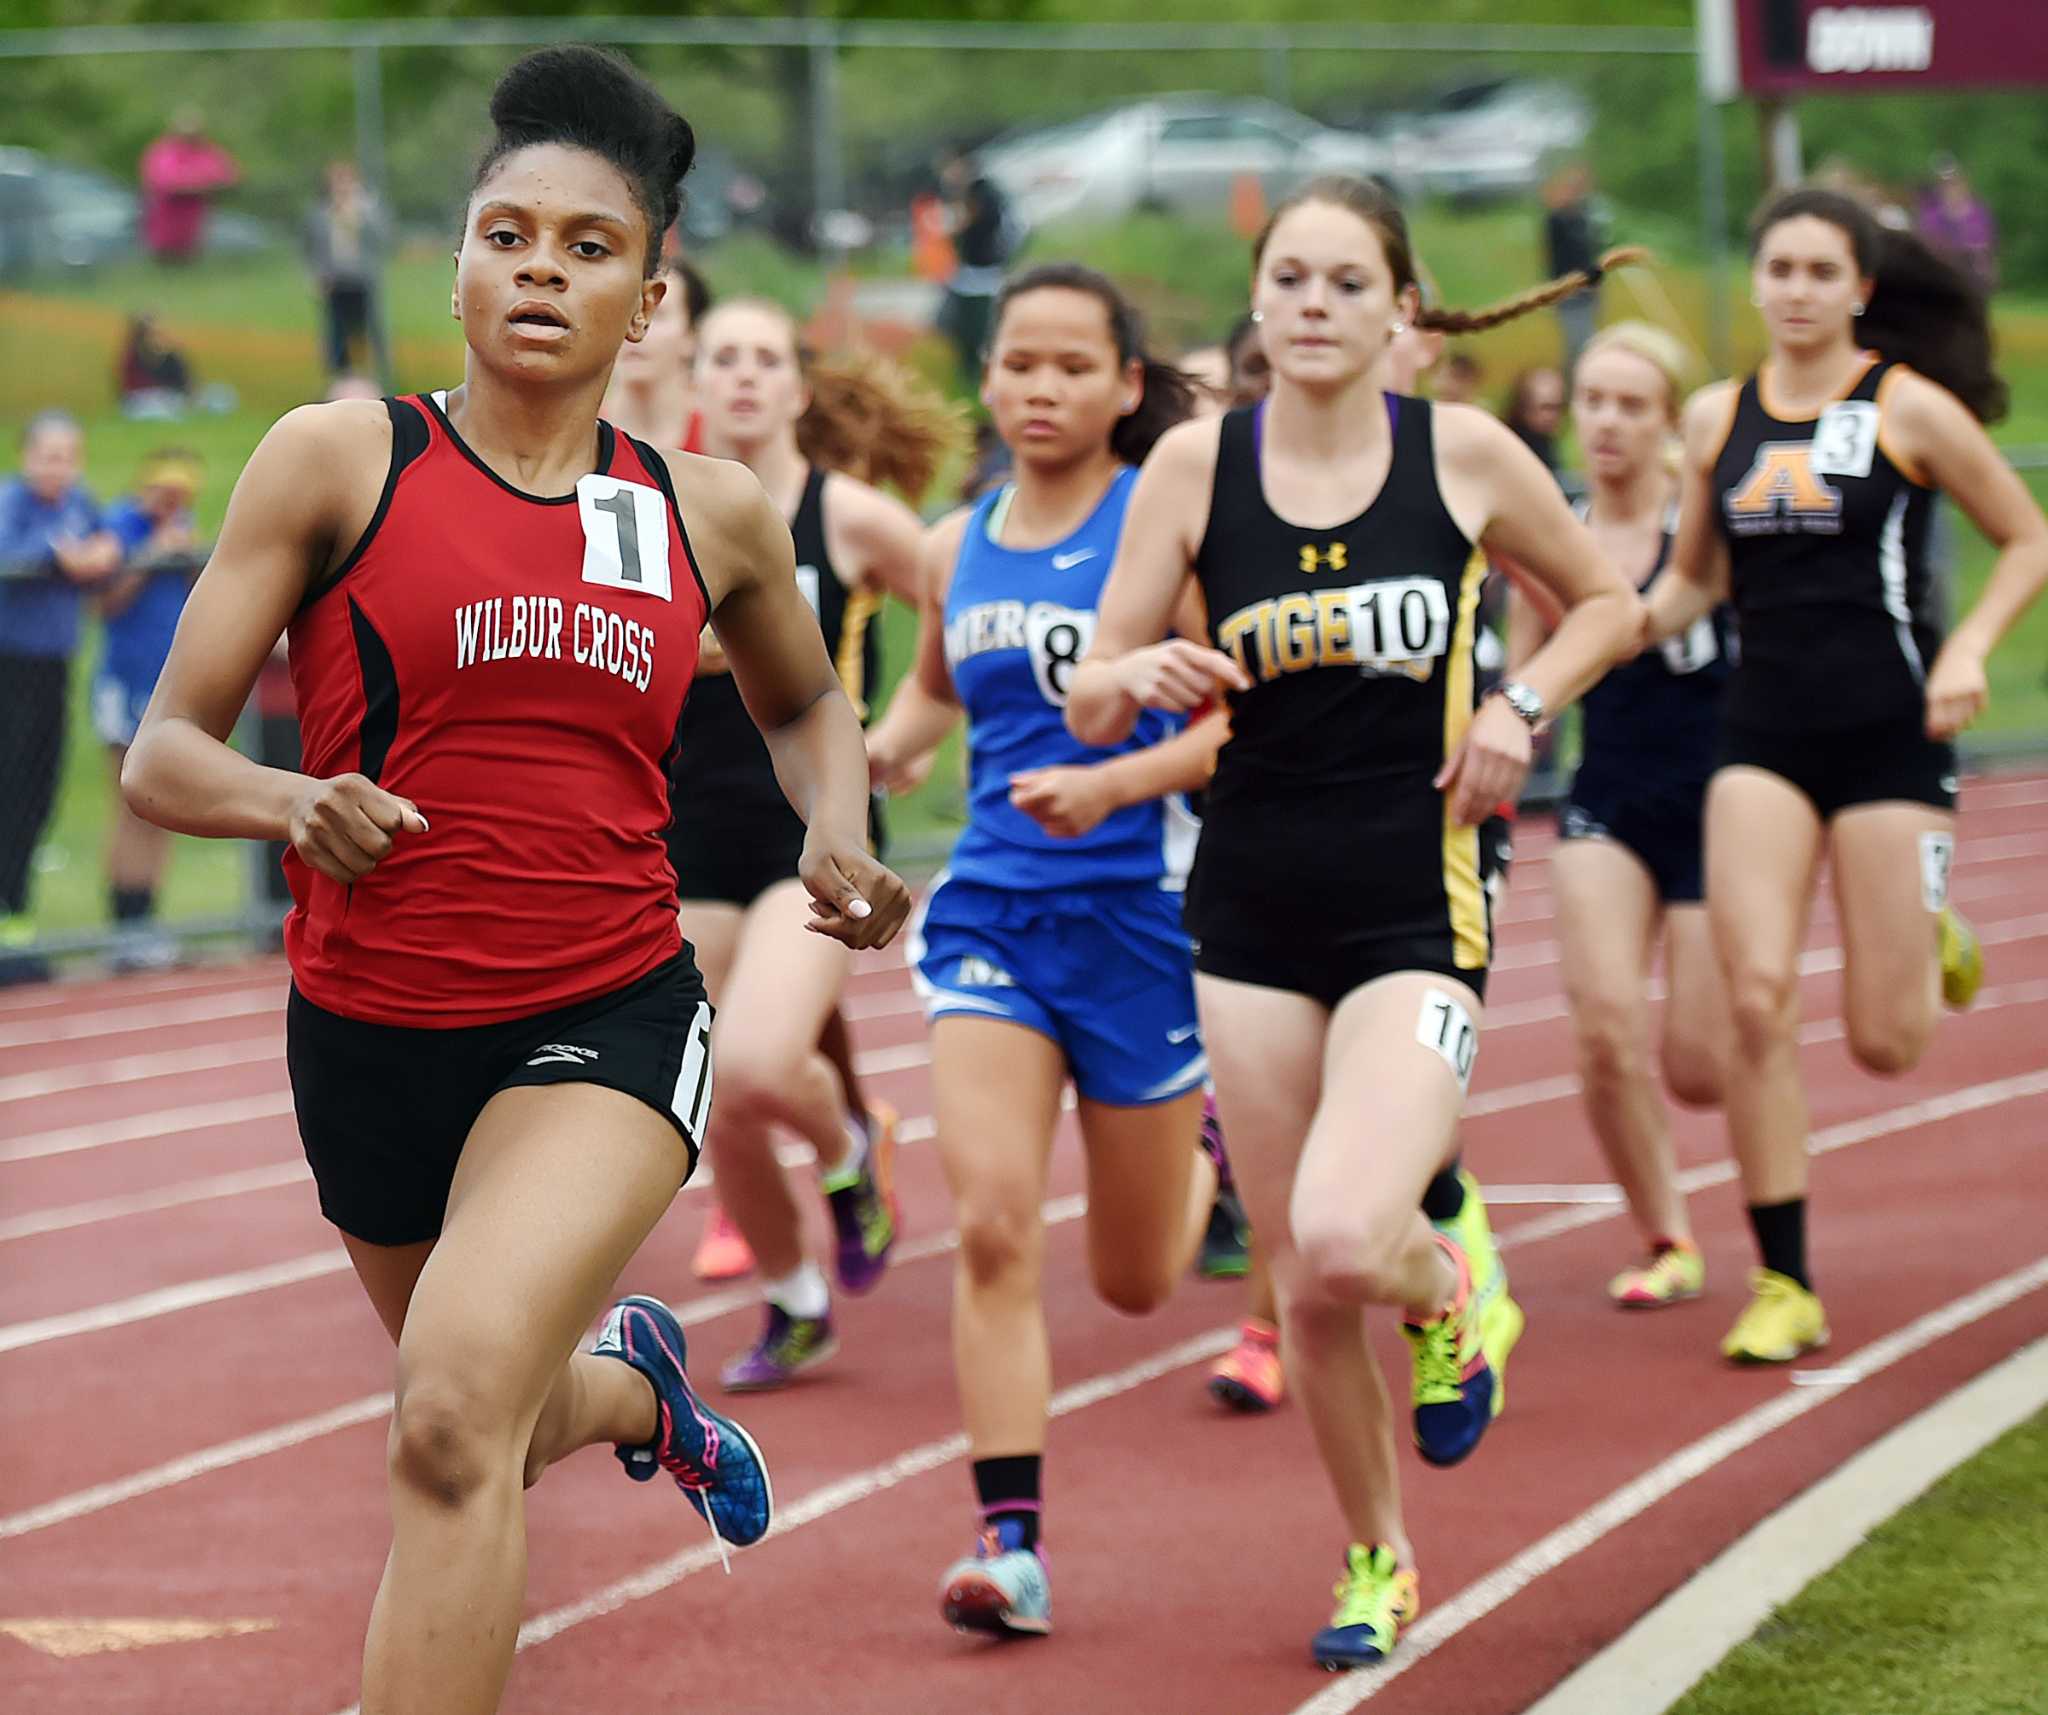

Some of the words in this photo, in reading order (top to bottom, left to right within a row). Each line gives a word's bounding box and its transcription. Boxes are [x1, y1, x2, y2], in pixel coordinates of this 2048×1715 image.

[1826, 414, 1862, 465] 3
[1724, 440, 1842, 516] A
[593, 488, 642, 583] 1
[455, 596, 563, 670] WILBUR
[573, 602, 655, 693] CROSS
[1218, 587, 1434, 685] TIGE
[1360, 589, 1432, 651] 10
[1044, 624, 1079, 695] 8
[690, 1025, 710, 1132] 1
[1434, 1003, 1473, 1079] 10
